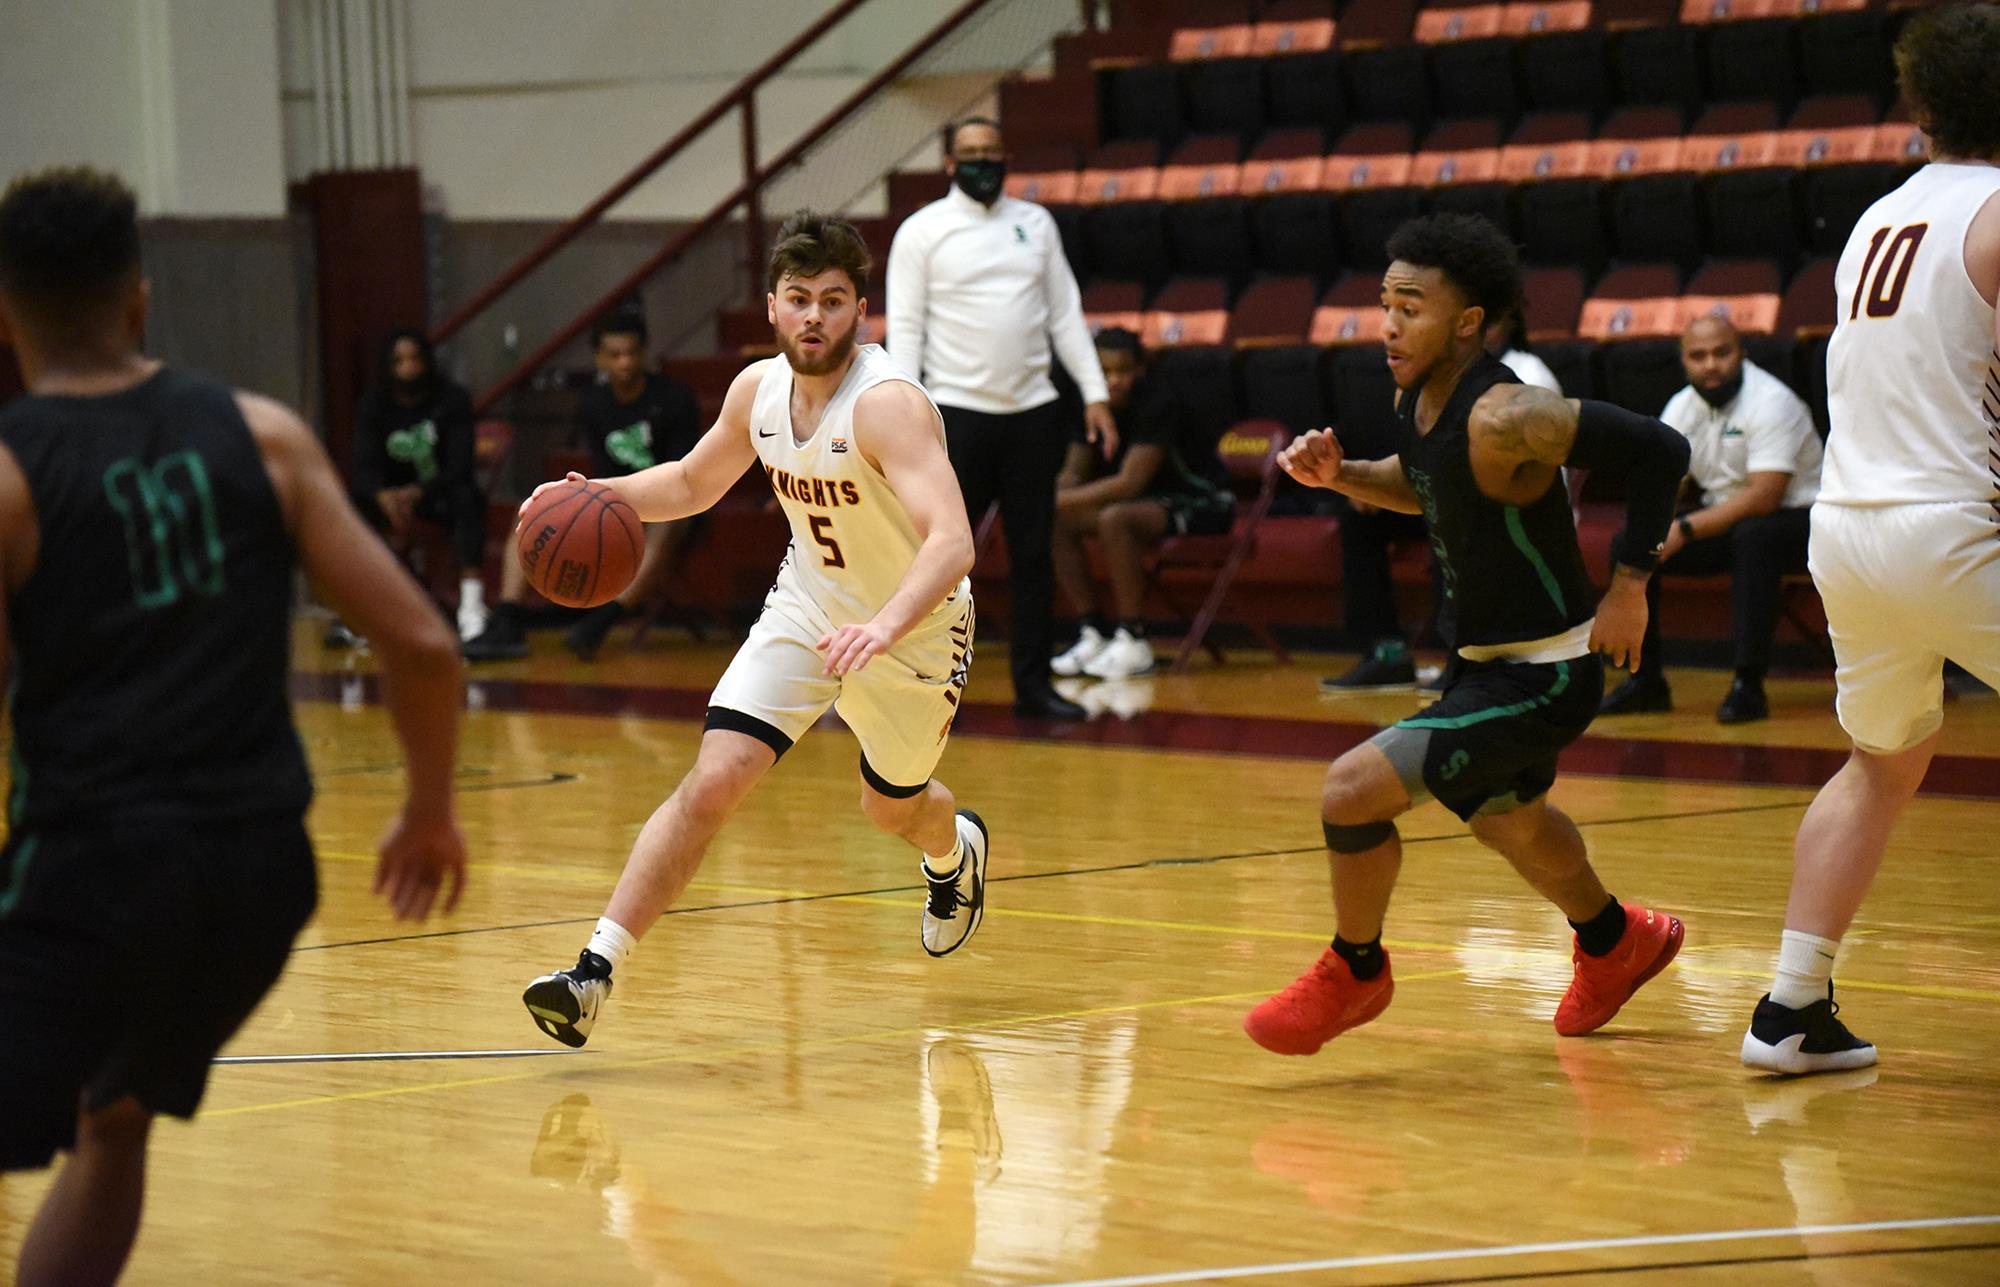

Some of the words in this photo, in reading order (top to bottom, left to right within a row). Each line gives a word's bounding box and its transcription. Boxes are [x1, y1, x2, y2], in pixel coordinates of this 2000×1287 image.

[1849, 223, 1929, 322] 10
[103, 451, 224, 608] 11
[807, 513, 846, 569] 5
